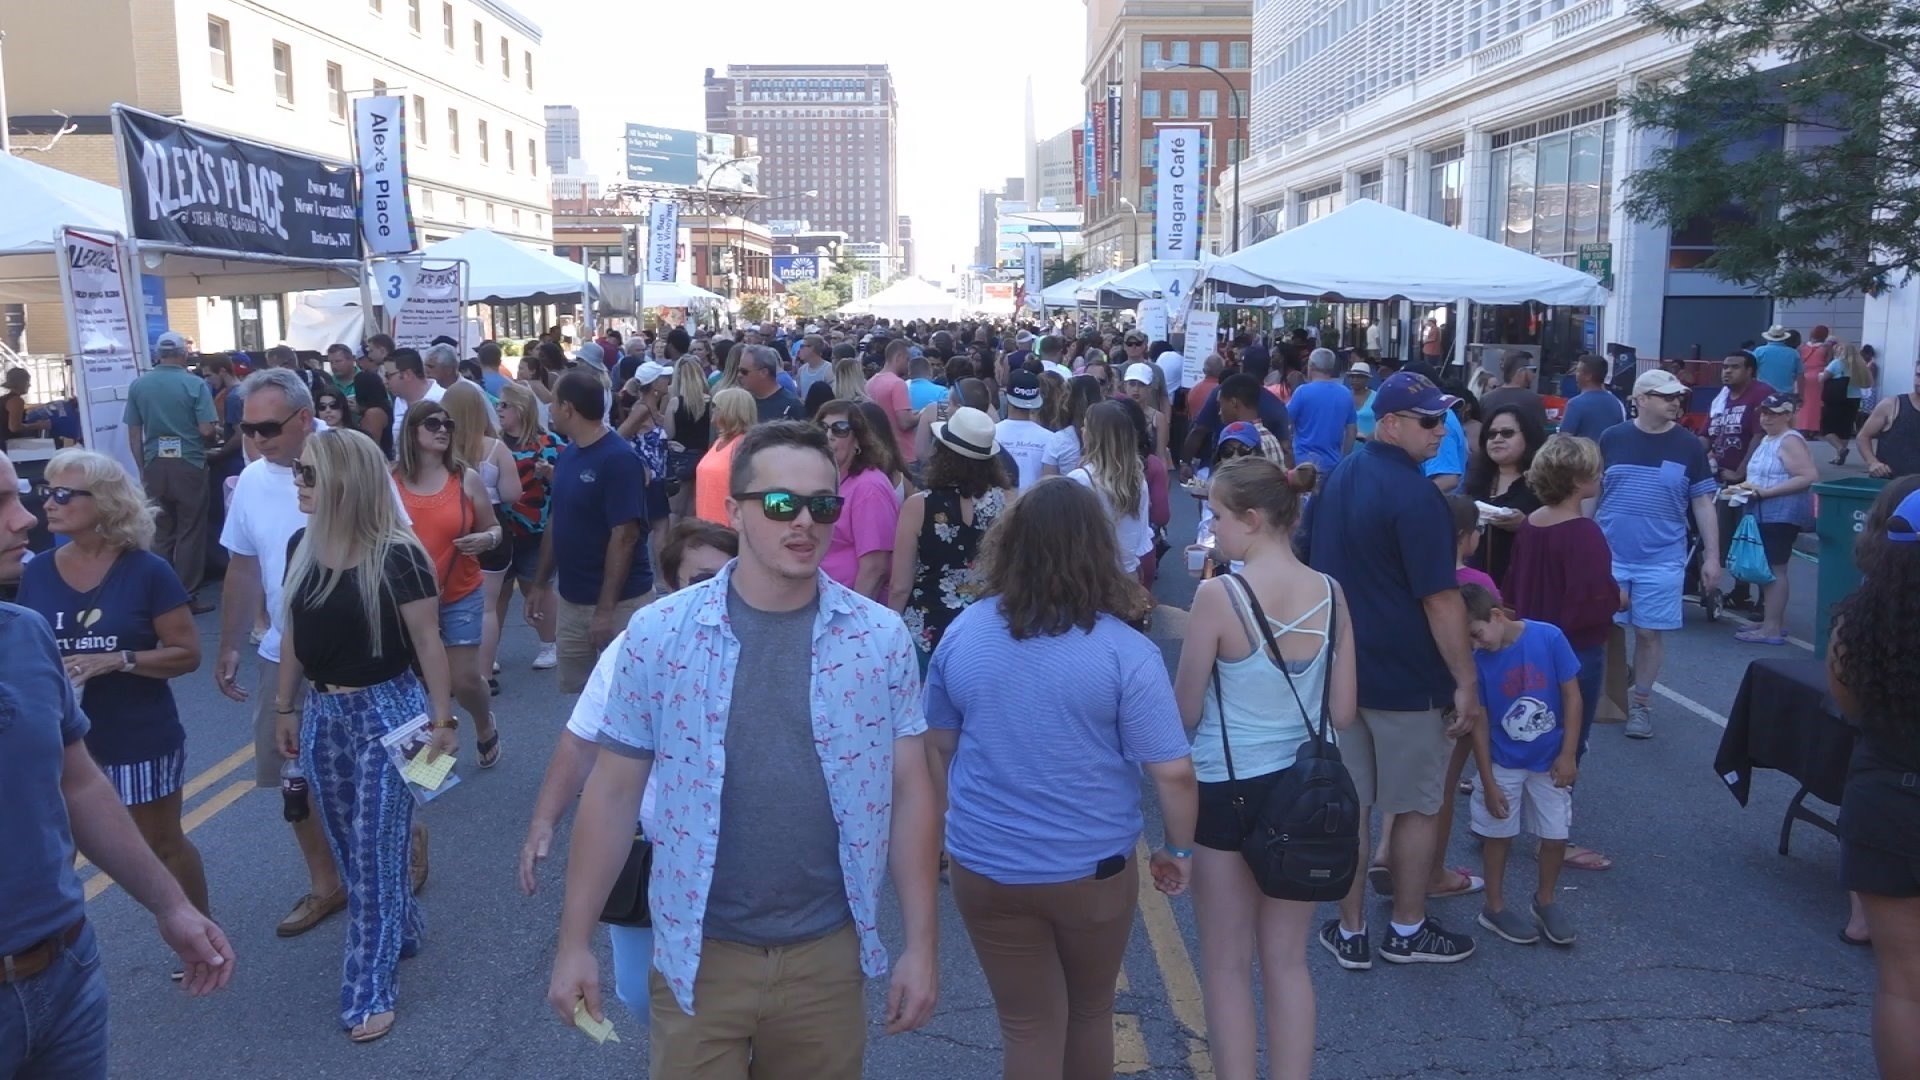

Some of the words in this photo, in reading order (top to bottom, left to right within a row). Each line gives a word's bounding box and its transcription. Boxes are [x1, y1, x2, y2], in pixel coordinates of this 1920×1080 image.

[370, 111, 388, 173] Alex's
[1170, 137, 1186, 178] Café
[141, 140, 221, 220] ALEX'S
[220, 156, 289, 240] PLACE
[375, 180, 391, 237] Place
[1168, 184, 1187, 251] Niagara
[780, 266, 816, 279] inspire
[1588, 260, 1604, 269] PAY
[387, 275, 402, 299] 3
[1169, 279, 1181, 297] 4
[55, 611, 65, 630] I
